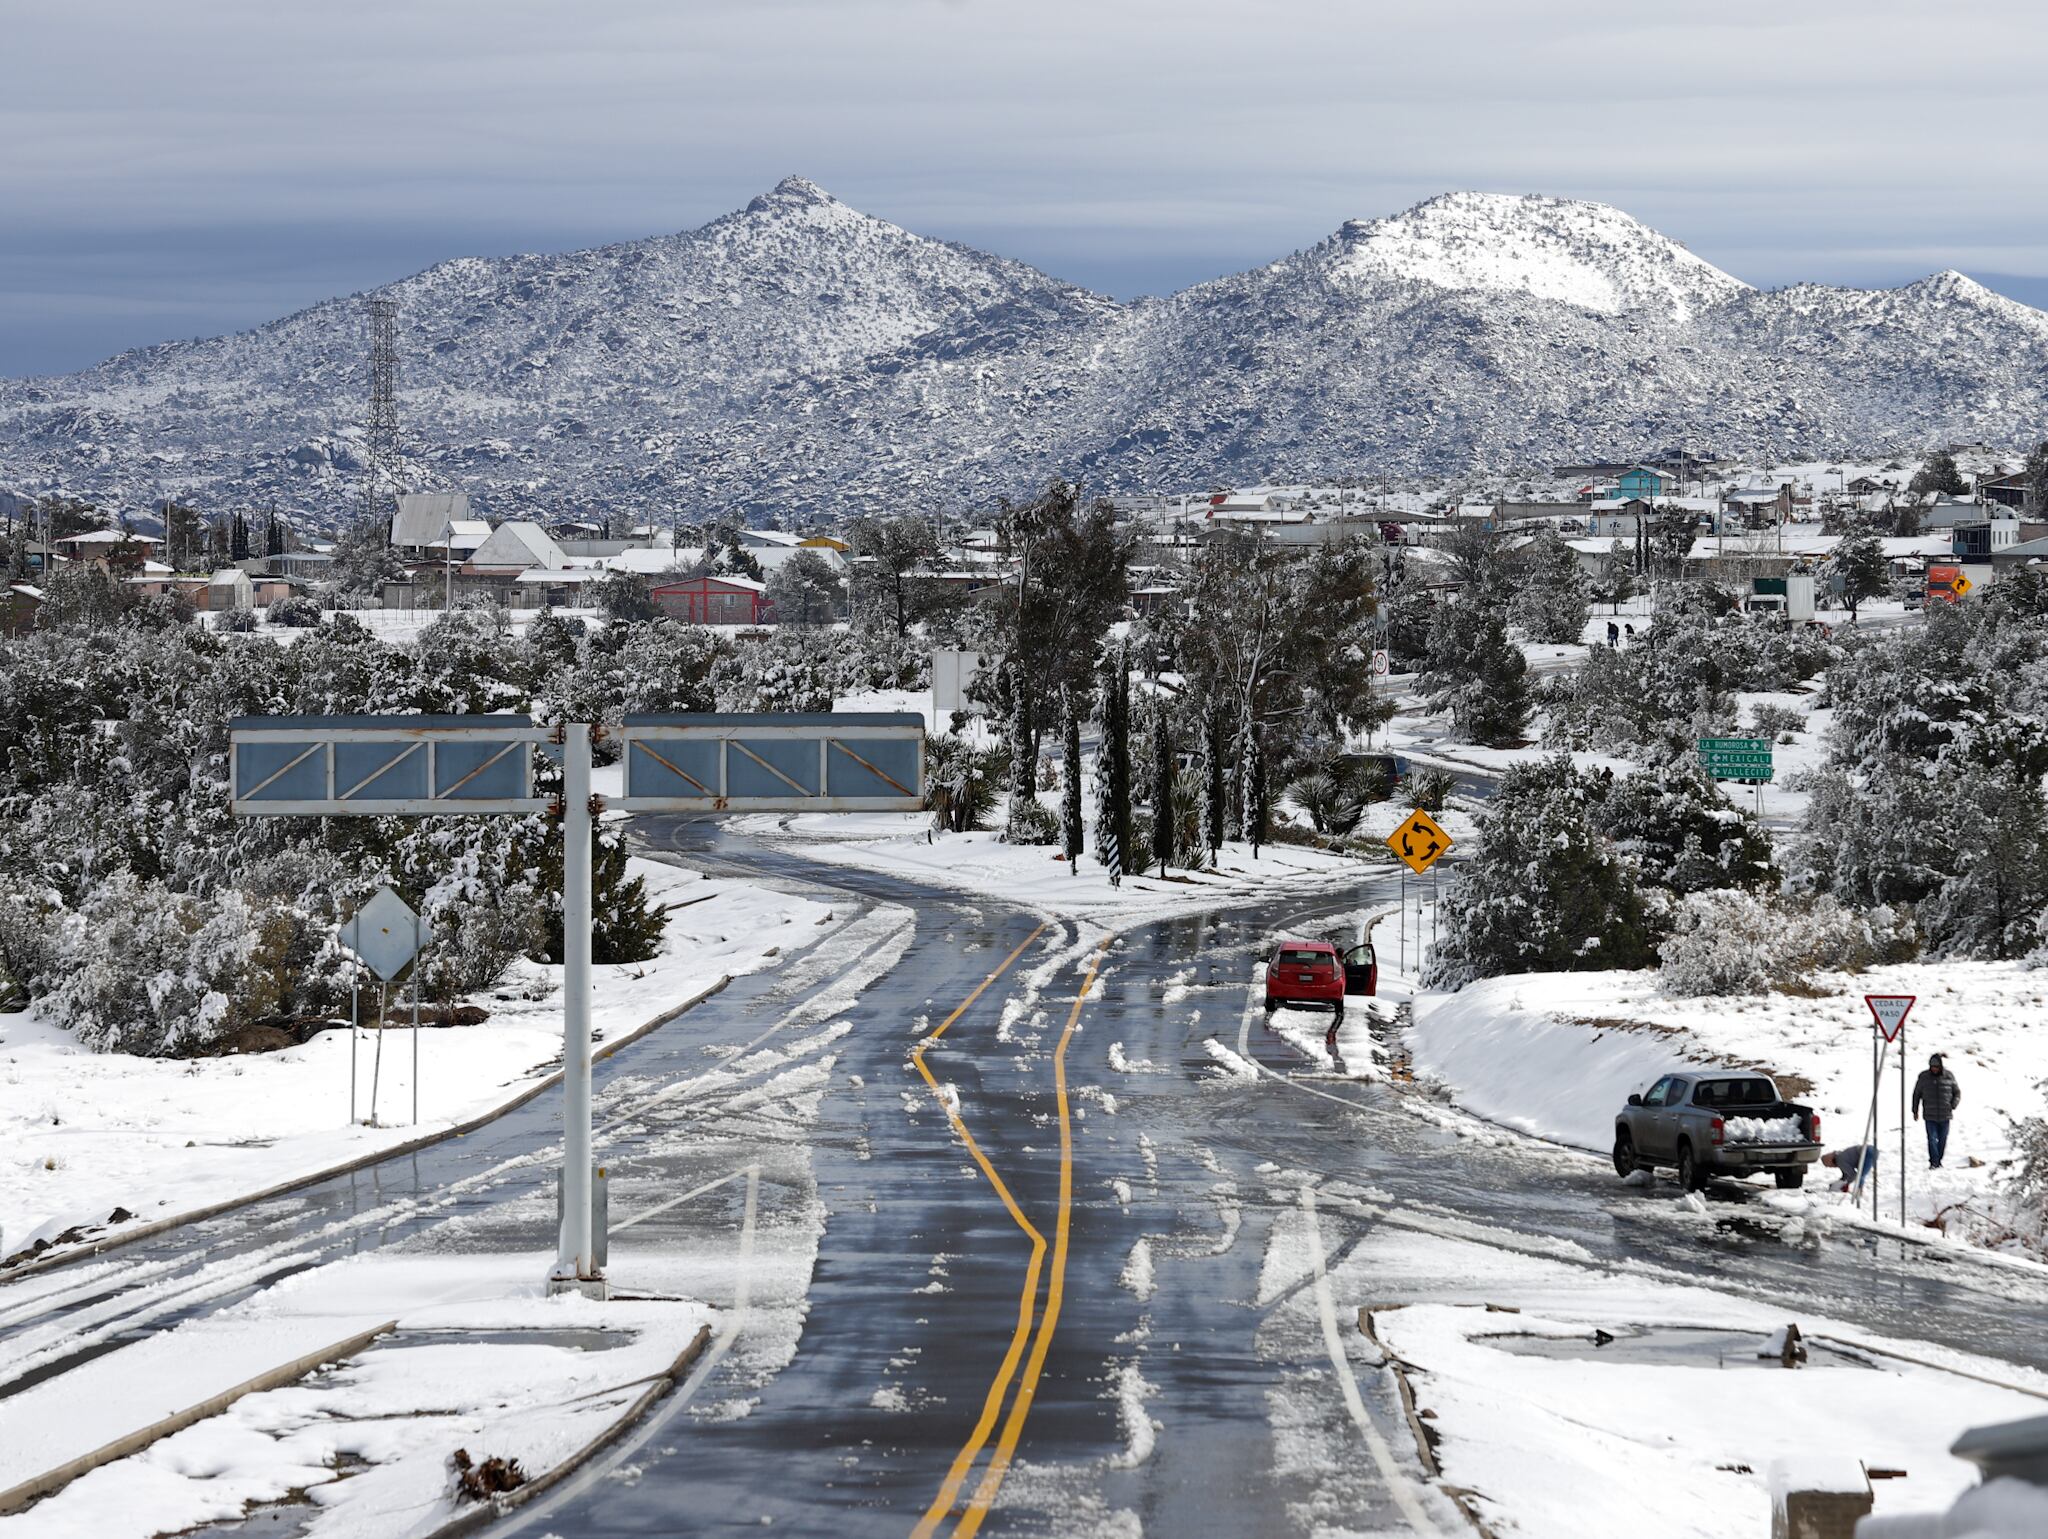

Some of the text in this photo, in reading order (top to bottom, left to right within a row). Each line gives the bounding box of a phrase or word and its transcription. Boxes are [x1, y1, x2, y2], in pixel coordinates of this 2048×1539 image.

[1701, 741, 1749, 749] LA RUMOROSA
[1722, 754, 1769, 763] MEXICALI
[1722, 768, 1770, 776] VALLECITO
[1879, 1010, 1900, 1018] PASO
